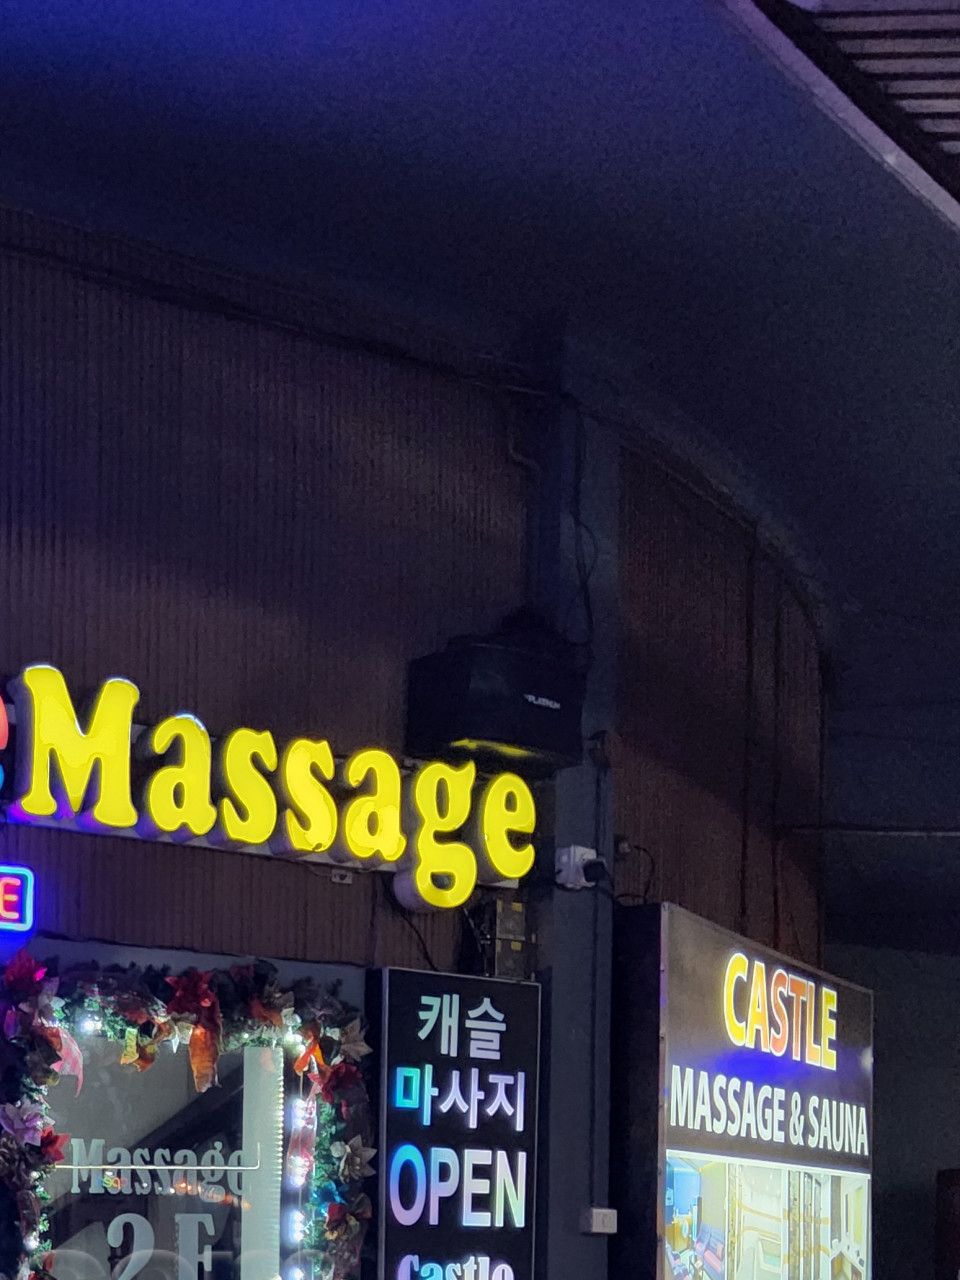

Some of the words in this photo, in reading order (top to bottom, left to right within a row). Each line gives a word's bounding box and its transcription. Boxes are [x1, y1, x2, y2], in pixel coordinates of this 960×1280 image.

[21, 664, 536, 908] Massage
[417, 993, 507, 1060] 캐슬
[723, 952, 837, 1071] CASTLE
[395, 1064, 525, 1132] 마사지
[670, 1064, 786, 1143] MASSAGE
[790, 1091, 804, 1146] &
[808, 1095, 869, 1156] SAUNA
[71, 1138, 248, 1202] Massage
[390, 1144, 527, 1228] OPEN
